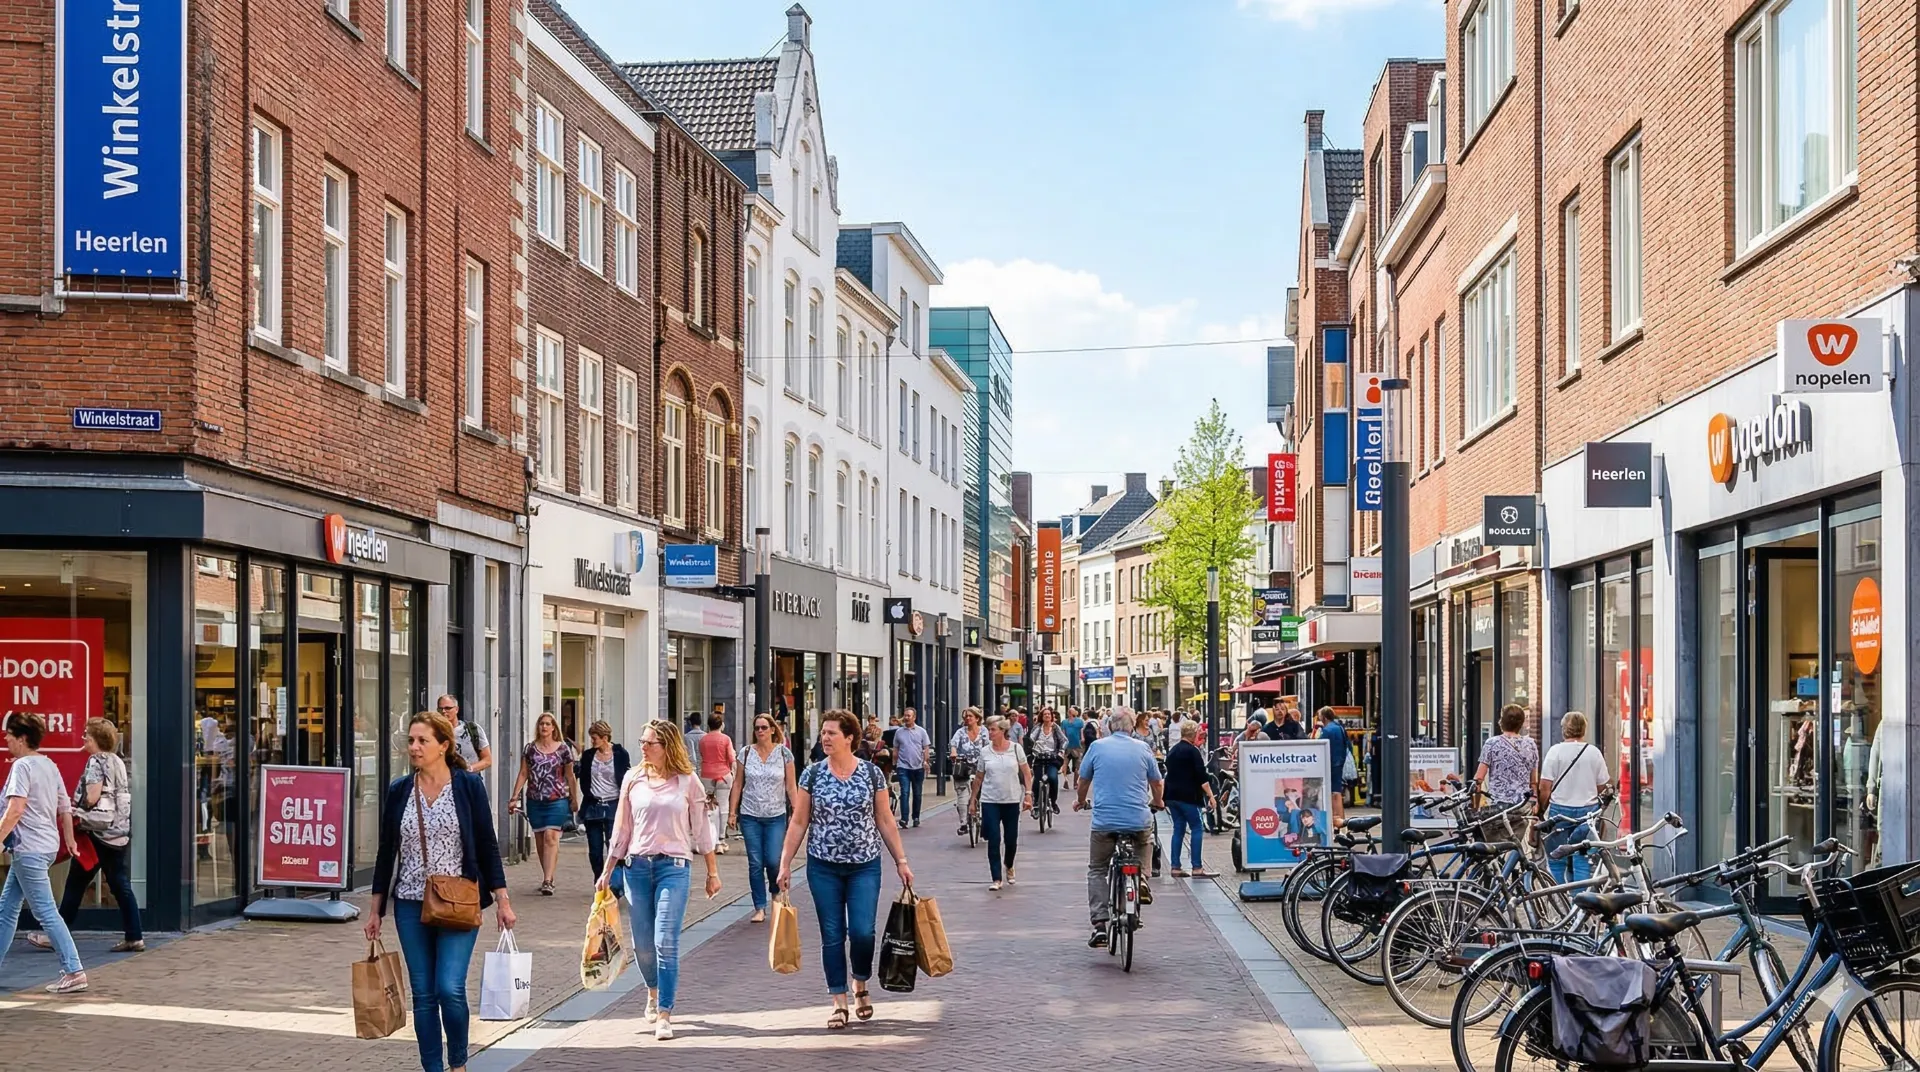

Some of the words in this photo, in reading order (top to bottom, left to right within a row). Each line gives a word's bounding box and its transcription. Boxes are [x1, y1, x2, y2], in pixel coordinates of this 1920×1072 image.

[75, 230, 168, 254] Heerlen
[1795, 370, 1871, 389] nopelen
[79, 411, 154, 427] Winkelstraat
[1591, 469, 1646, 480] Heerlen
[13, 685, 39, 705] IN
[1249, 753, 1317, 764] Winkelstraat
